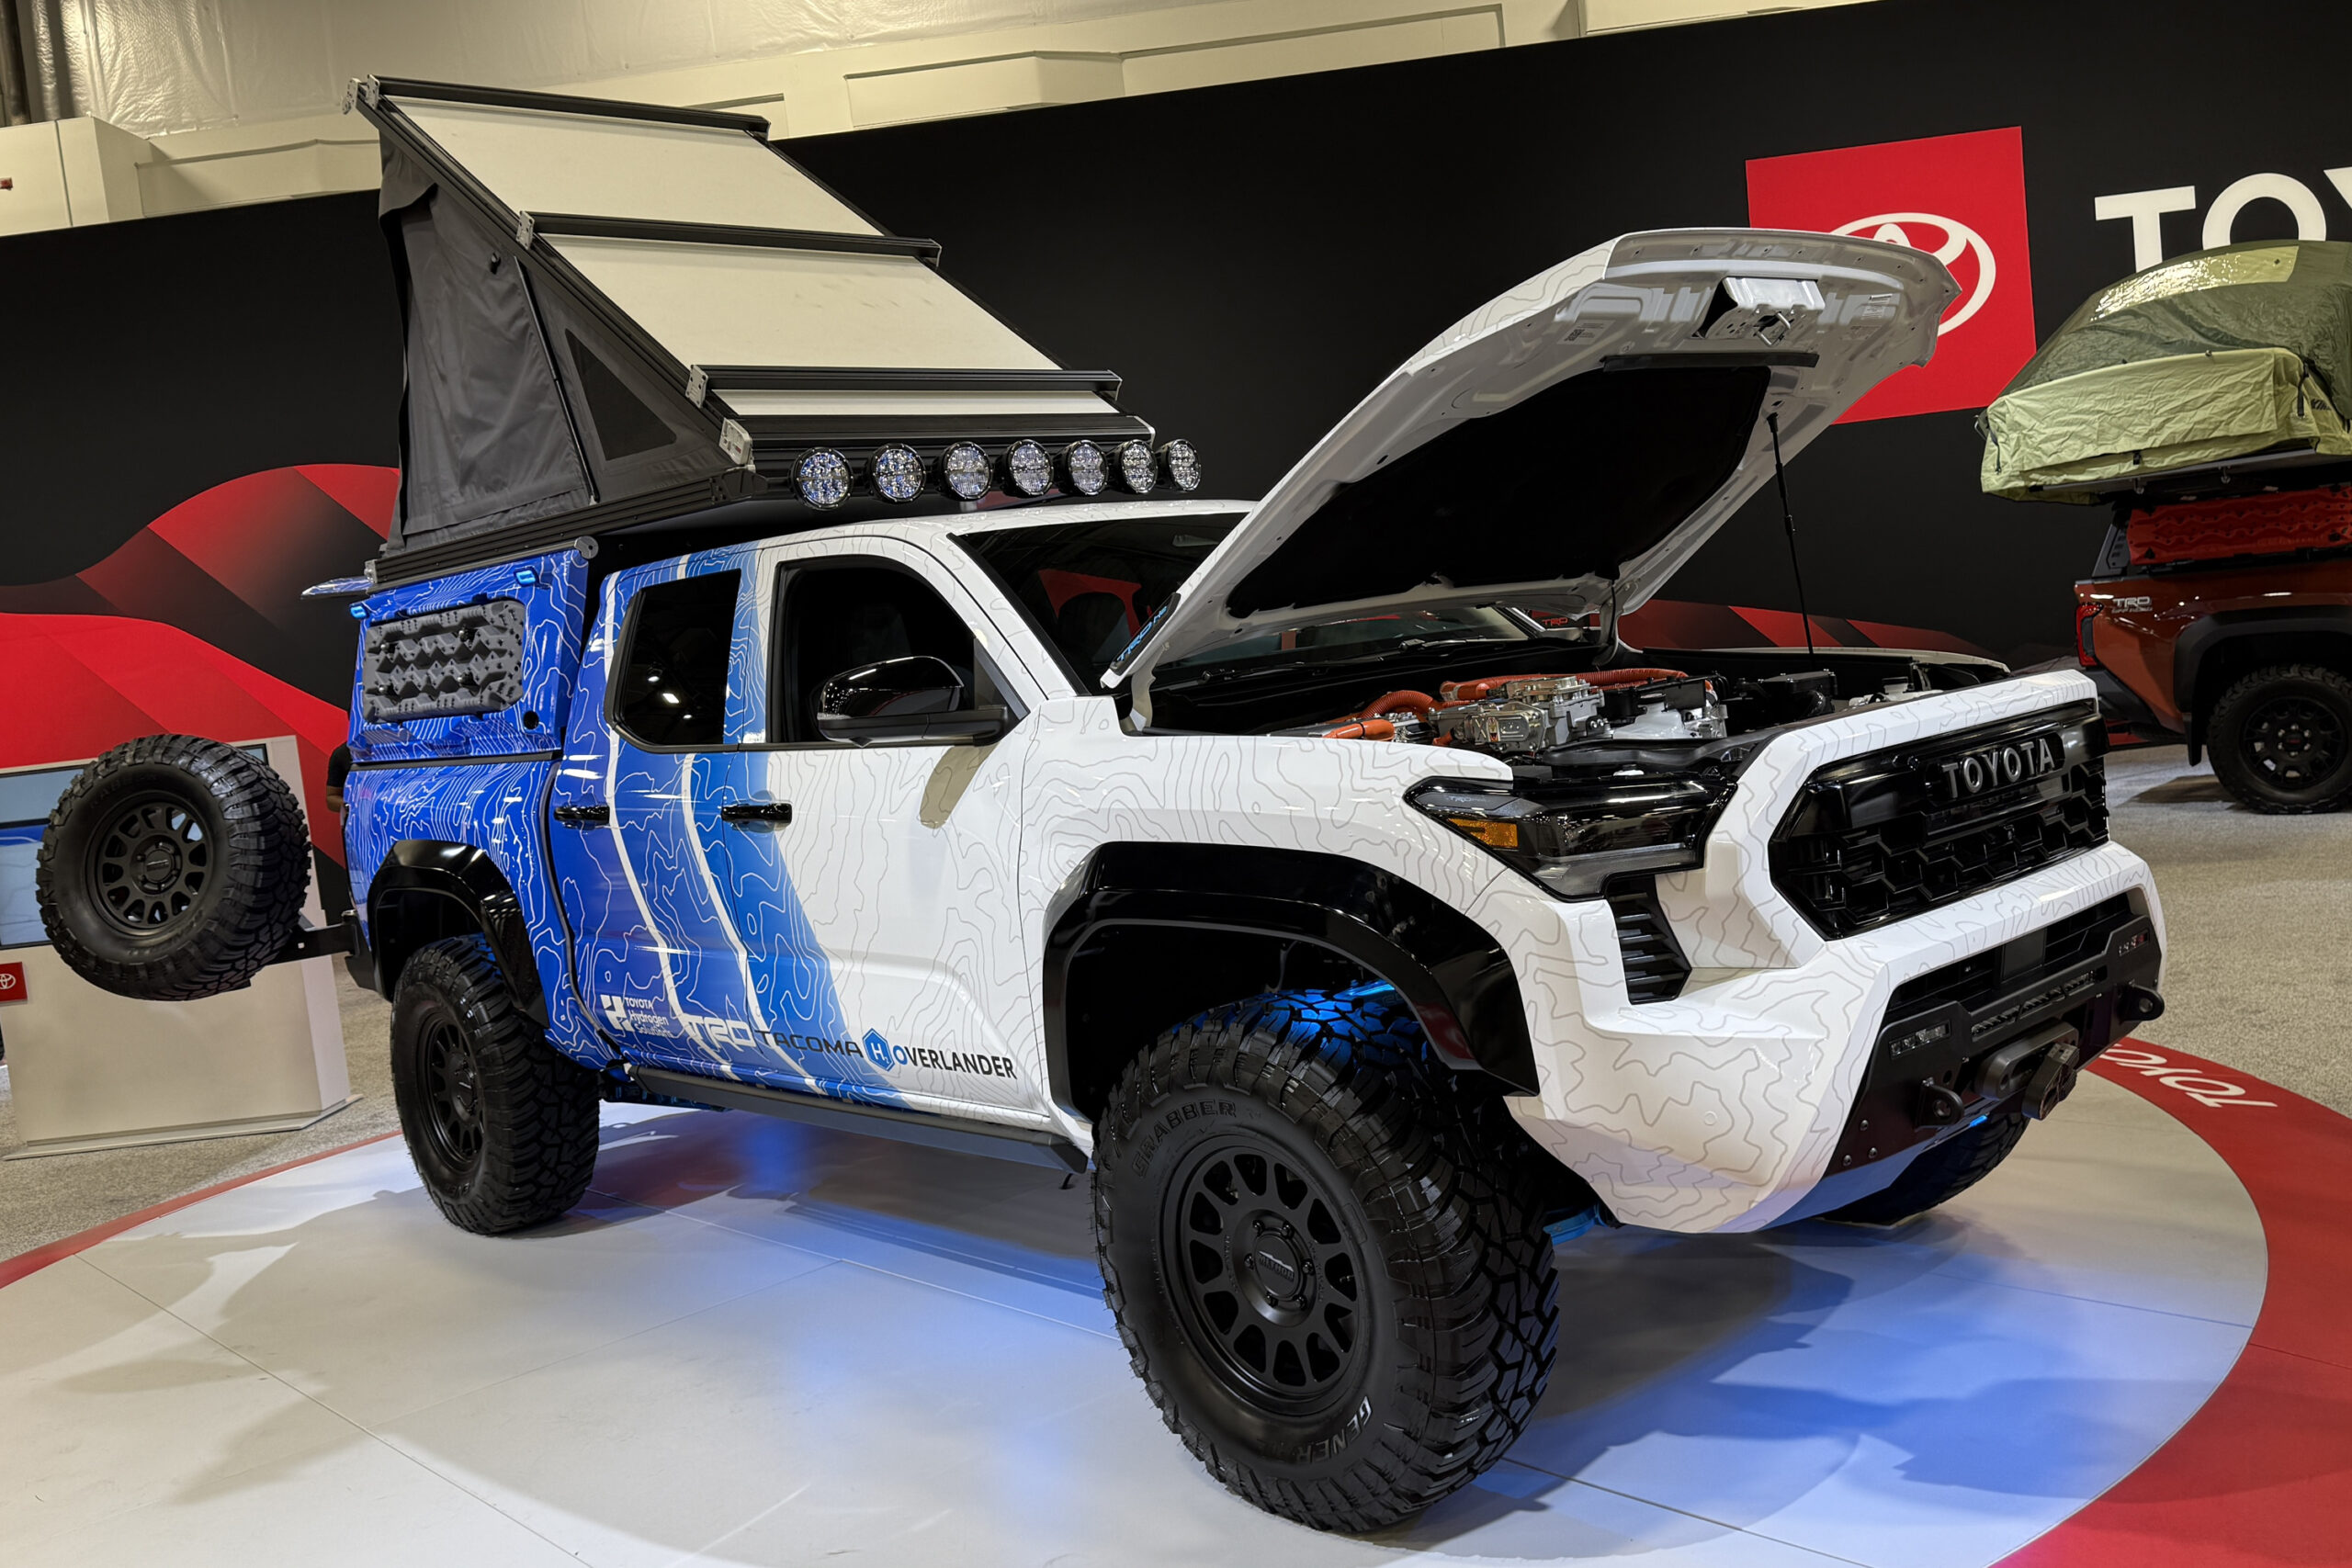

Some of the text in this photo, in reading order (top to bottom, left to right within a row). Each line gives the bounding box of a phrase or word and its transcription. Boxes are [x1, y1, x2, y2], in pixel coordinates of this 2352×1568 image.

[2094, 166, 2352, 273] TO
[1542, 616, 1568, 626] TRD
[2112, 595, 2151, 611] TRD
[1117, 621, 1153, 661] TRD
[1941, 738, 2055, 799] TOYOTA
[625, 997, 653, 1010] TOYOTA
[628, 1010, 669, 1026] Hydrogen
[634, 1023, 673, 1038] Solutions
[682, 1013, 757, 1052] TRD
[754, 1030, 864, 1058] TACOMA
[892, 1044, 1018, 1080] OVERLANDER
[2099, 1043, 2278, 1108] TOYO
[1131, 1098, 1237, 1177] GRABBER
